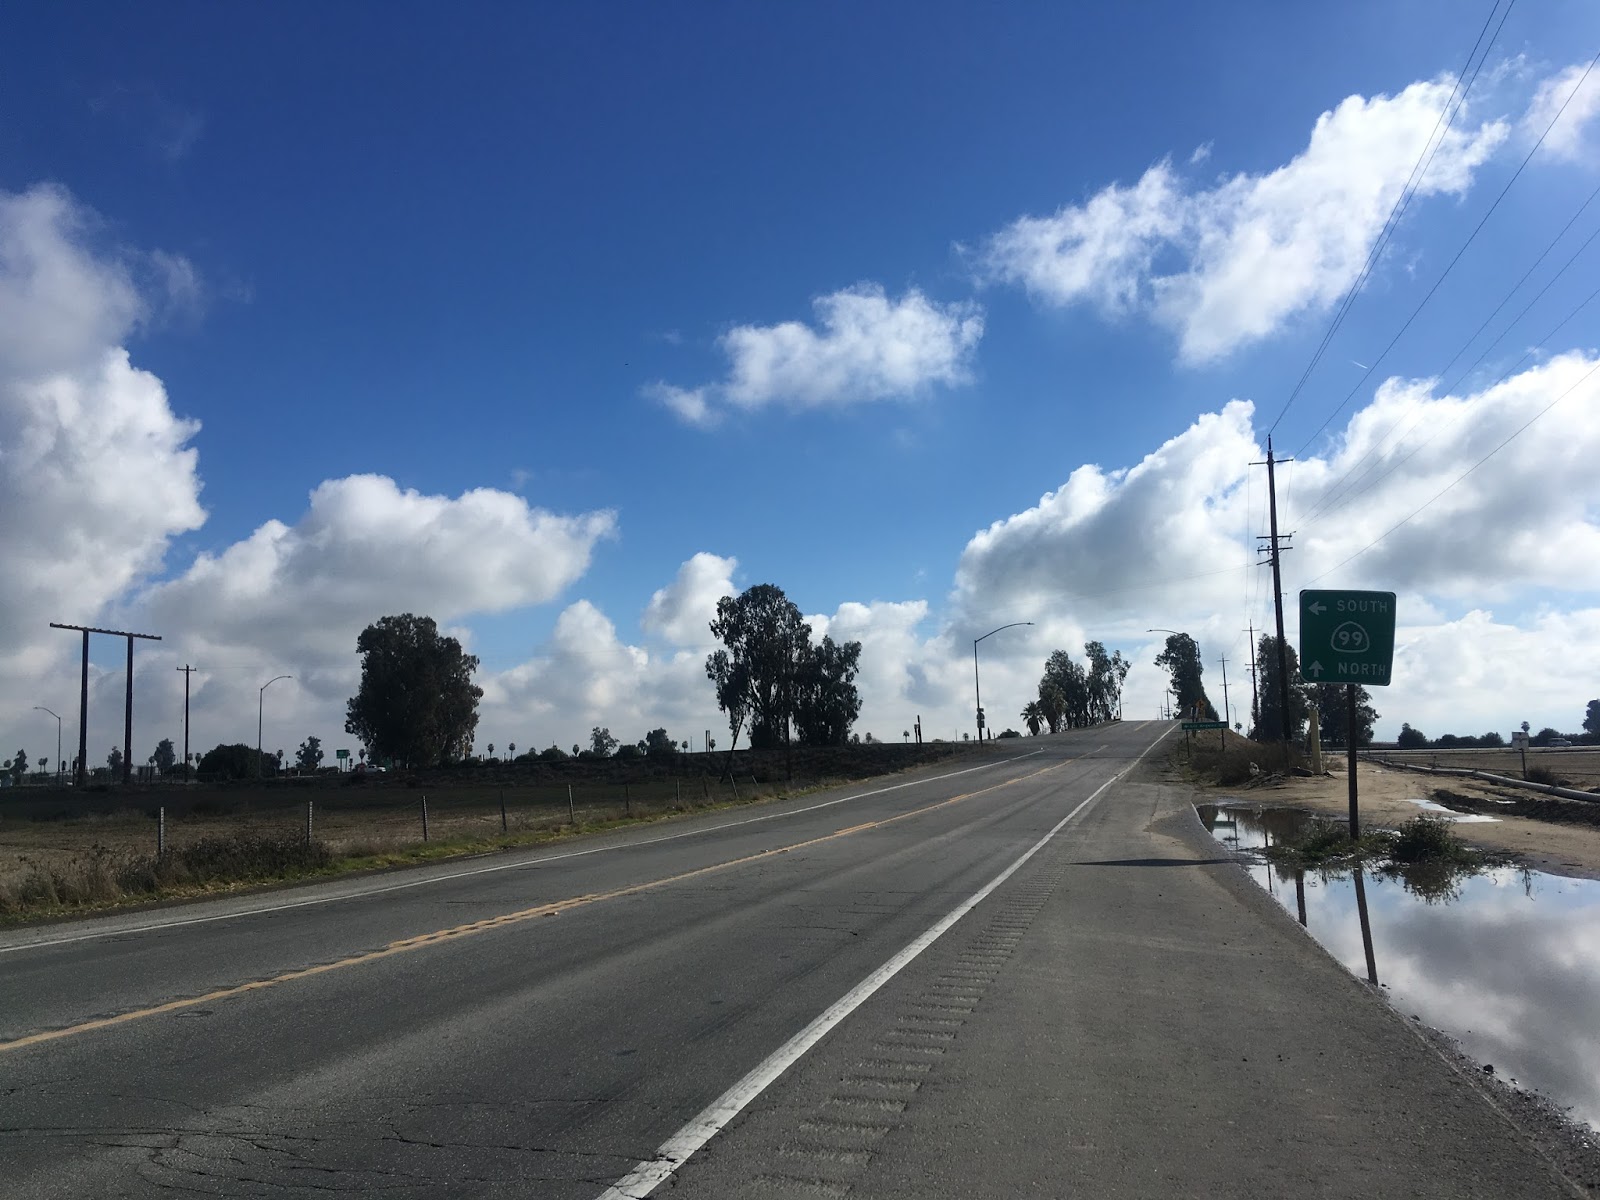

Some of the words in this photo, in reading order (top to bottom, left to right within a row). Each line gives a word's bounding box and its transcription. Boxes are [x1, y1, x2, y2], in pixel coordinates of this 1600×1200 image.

[1337, 600, 1388, 613] SOUTH
[1338, 631, 1363, 646] 99
[1338, 662, 1386, 675] NORTH
